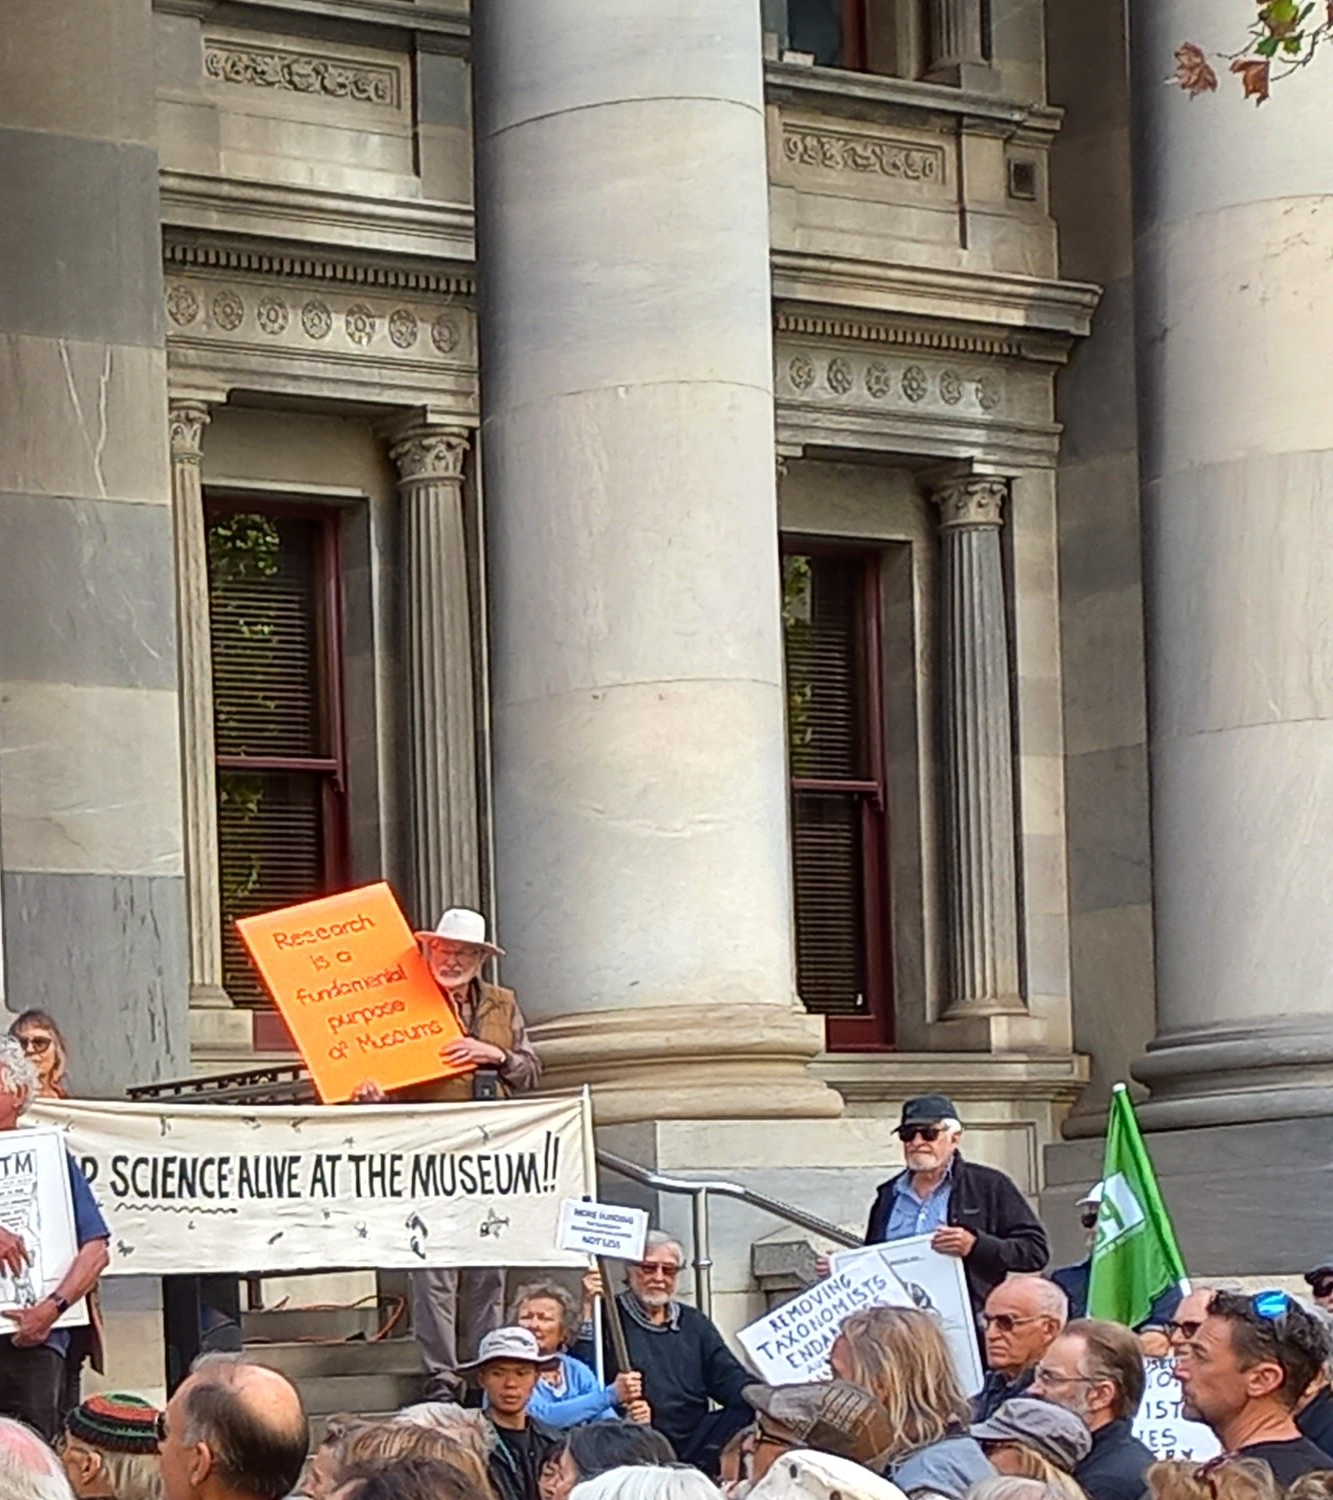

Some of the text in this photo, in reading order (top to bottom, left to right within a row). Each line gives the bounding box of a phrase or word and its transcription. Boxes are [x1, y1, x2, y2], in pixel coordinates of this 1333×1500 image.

[272, 914, 376, 950] Research
[310, 950, 353, 971] is a
[327, 999, 406, 1034] purpose
[356, 1020, 443, 1054] Museums
[110, 1155, 231, 1199] SCIENCE
[238, 1154, 302, 1199] ALIVE
[310, 1154, 342, 1198] AT
[348, 1154, 404, 1198] THE
[410, 1131, 560, 1199] MUSEUM!!
[756, 1274, 887, 1360] TAXONOMISTS
[769, 1274, 852, 1333] REMOVING
